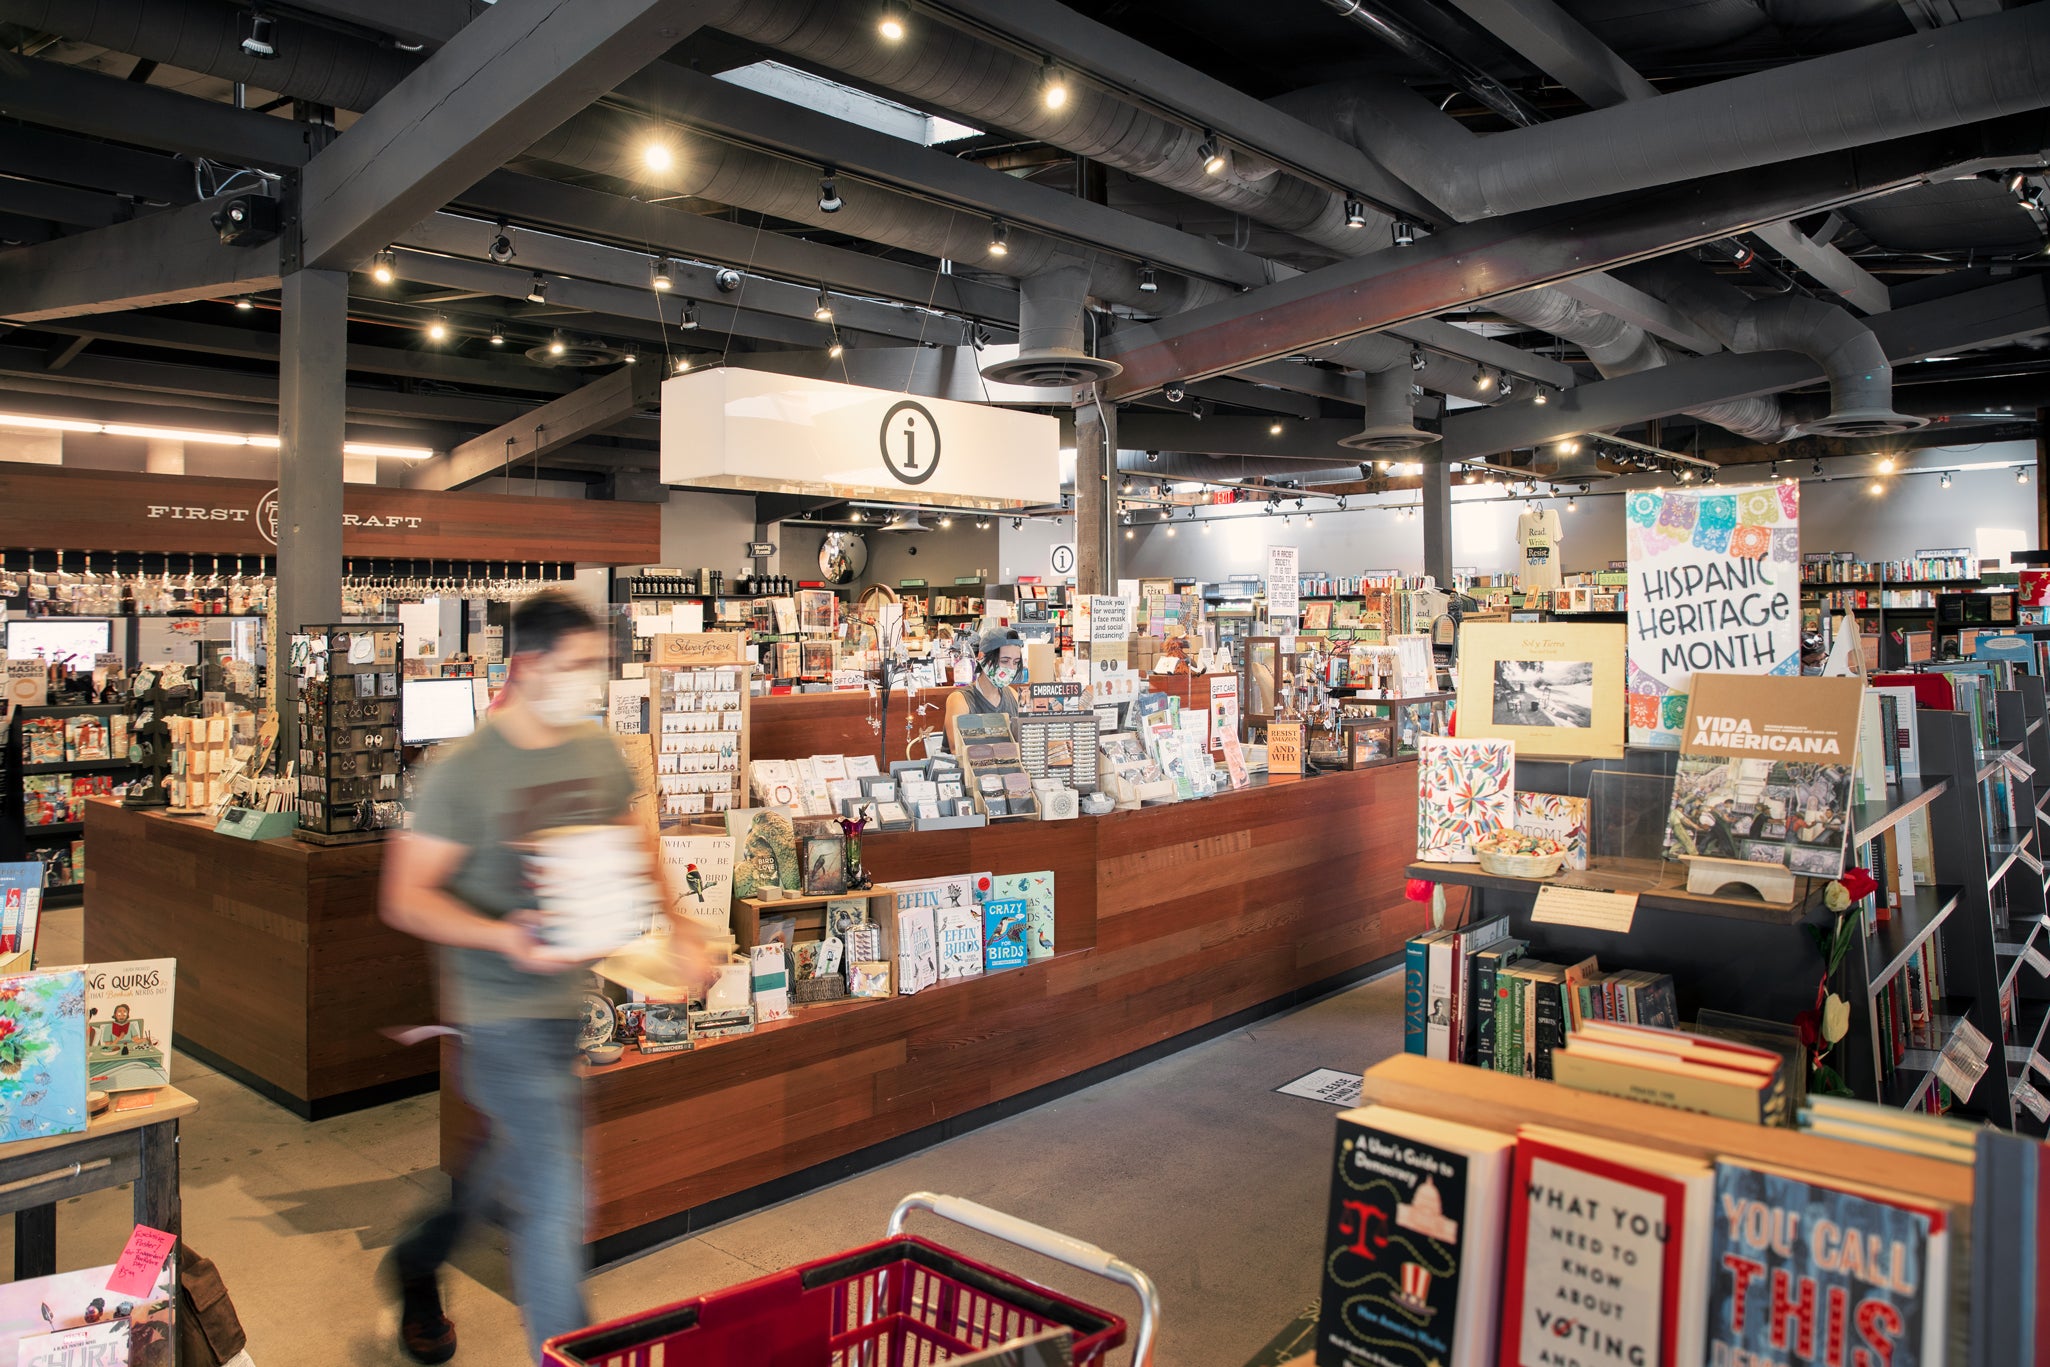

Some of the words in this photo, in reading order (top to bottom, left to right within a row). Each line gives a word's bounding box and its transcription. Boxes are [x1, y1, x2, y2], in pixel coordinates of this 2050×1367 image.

[1217, 491, 1231, 504] EXIT
[147, 505, 249, 521] FIRST
[342, 514, 422, 528] RAFT
[1642, 552, 1774, 602] HISPANIC
[1103, 608, 1126, 616] wearing
[1416, 610, 1431, 618] ead.
[1094, 632, 1125, 640] distancing!
[1662, 630, 1776, 674] MONTH
[7, 665, 44, 673] MASKS
[1033, 685, 1079, 696] EMBRACELETS
[616, 721, 640, 732] FIRST
[1695, 716, 1753, 734] VIDA
[1514, 824, 1562, 842] OTOMI
[712, 841, 731, 849] IT'S
[663, 857, 684, 865] LIKE
[990, 903, 1023, 915] CRAZY
[944, 926, 980, 943] EFFIN'
[944, 940, 980, 961] BIRDS
[987, 946, 1024, 959] BIRDS
[112, 970, 159, 991] QUIRKS
[1407, 970, 1423, 1035] GOYA
[1538, 1017, 1556, 1026] SPIRITS
[1316, 1079, 1352, 1095] PLEASE
[1324, 1088, 1353, 1101] STAND
[1356, 1134, 1368, 1151] A
[1368, 1137, 1401, 1162] User's
[1404, 1148, 1439, 1172] Guide
[1440, 1162, 1455, 1178] to
[1354, 1152, 1418, 1189] Democracy
[1526, 1182, 1599, 1221] WHAT
[1612, 1207, 1672, 1244] YOU
[1722, 1193, 1800, 1258] YOU
[1551, 1227, 1603, 1254] NEED
[1612, 1245, 1638, 1266] TO
[1811, 1218, 1916, 1297] CALL
[1562, 1258, 1623, 1291] KNOW
[1557, 1286, 1624, 1320] ABOUT
[1723, 1253, 1905, 1367] THIS
[1357, 1305, 1379, 1323] How
[1380, 1315, 1417, 1341] America
[1418, 1330, 1447, 1353] Works
[1536, 1308, 1645, 1366] VOTING
